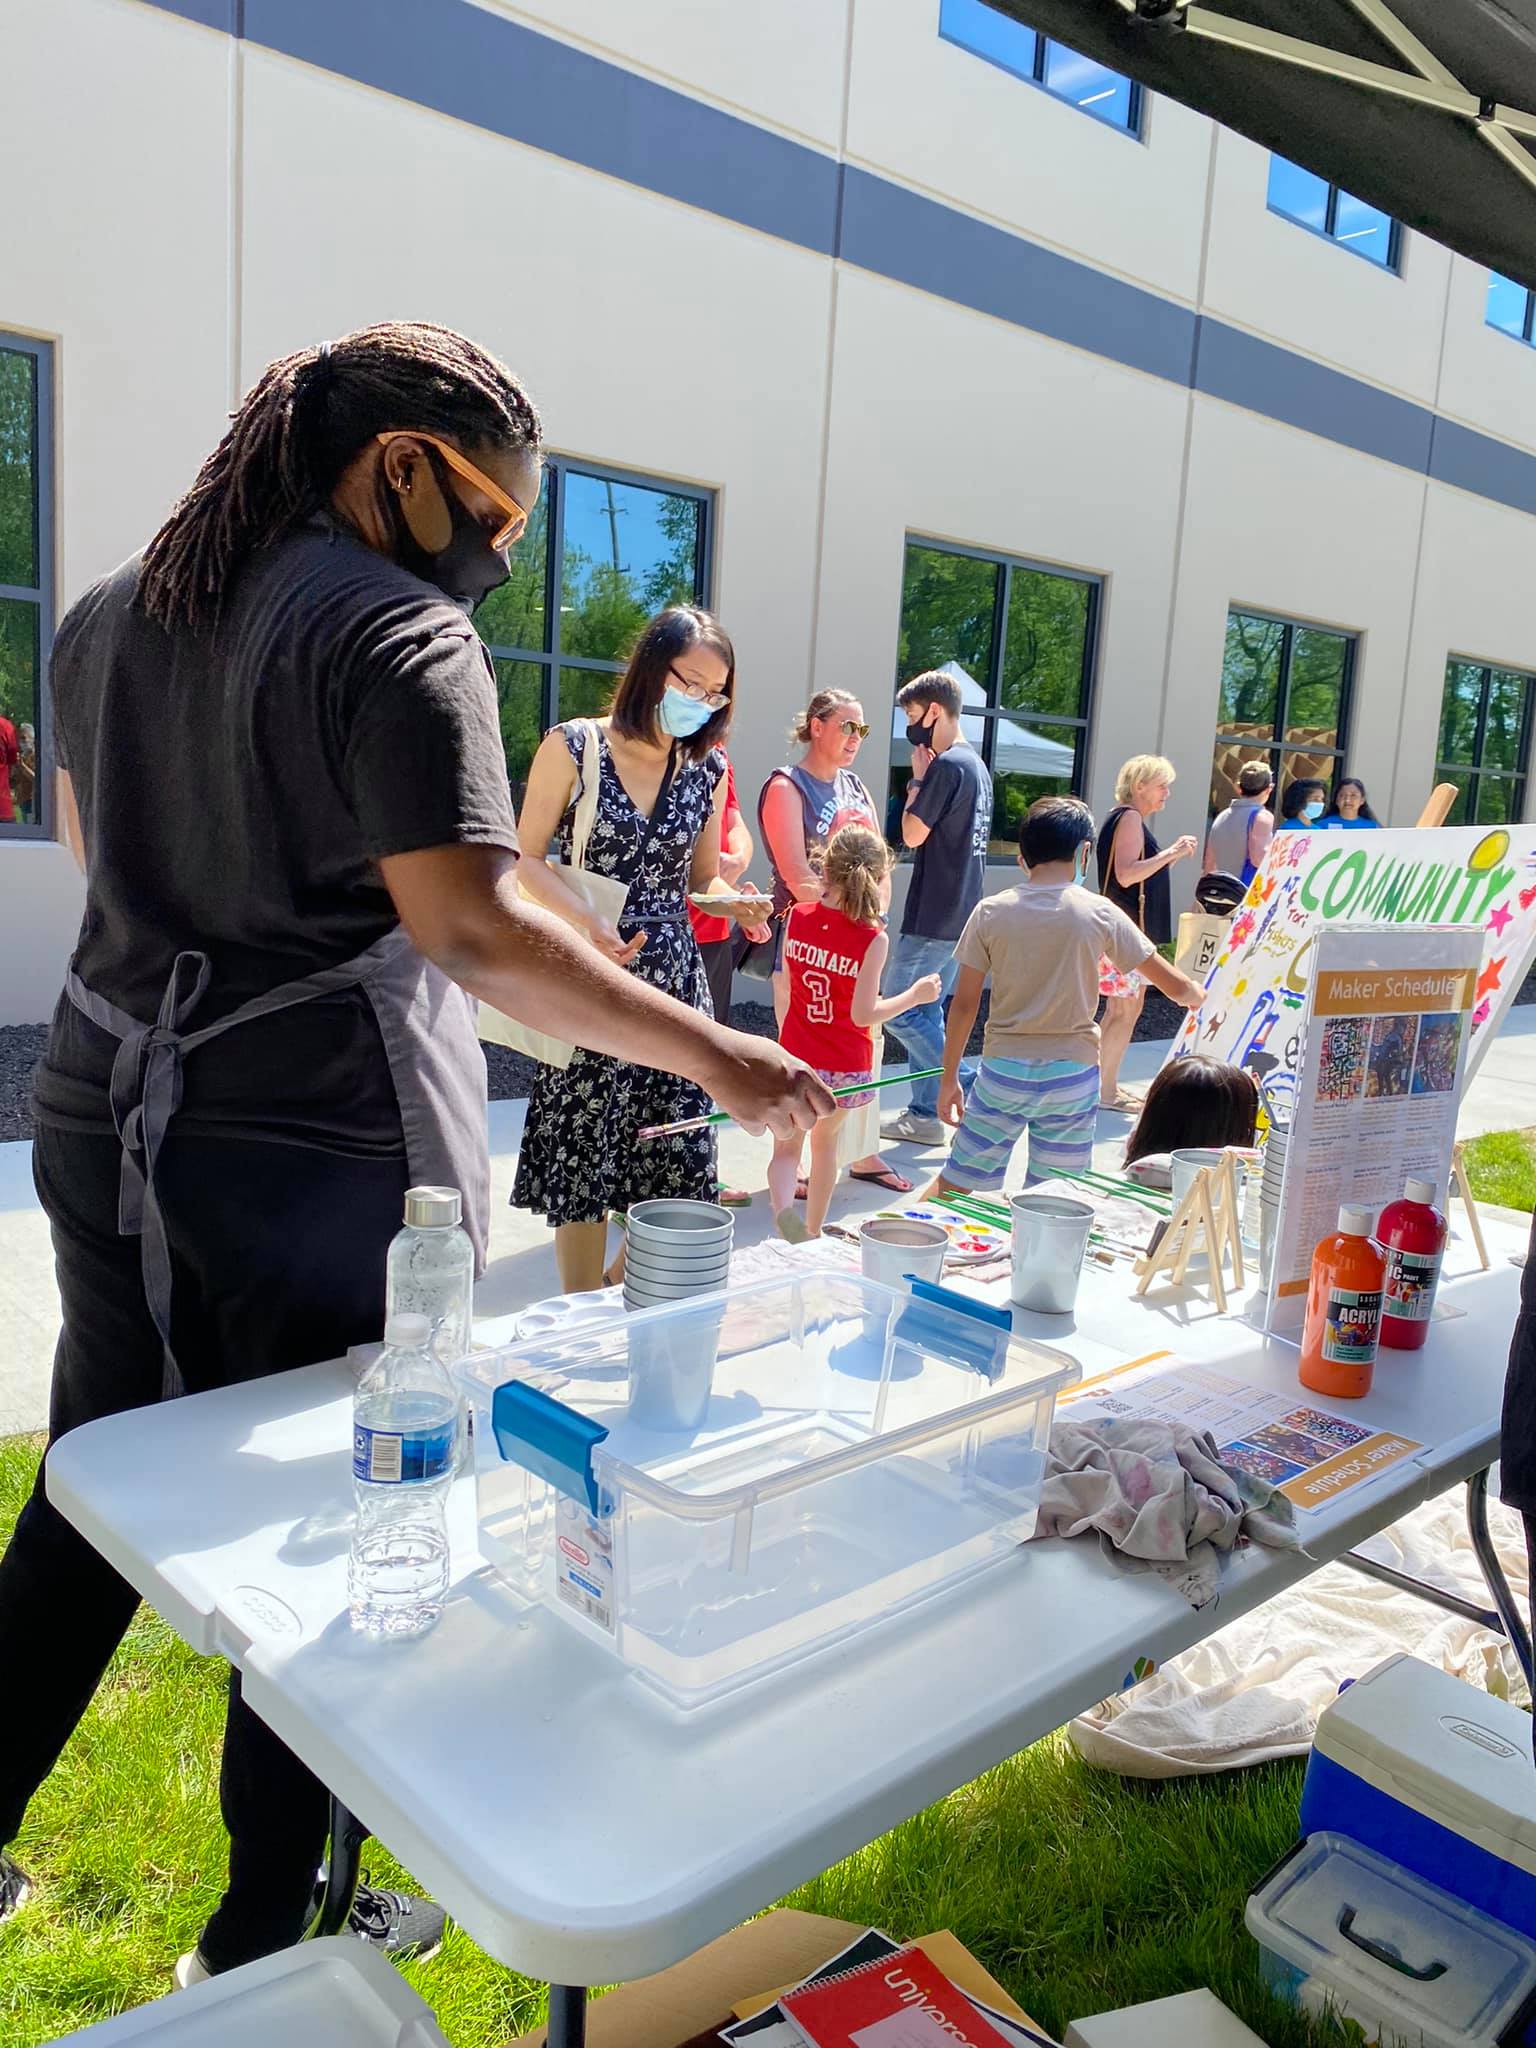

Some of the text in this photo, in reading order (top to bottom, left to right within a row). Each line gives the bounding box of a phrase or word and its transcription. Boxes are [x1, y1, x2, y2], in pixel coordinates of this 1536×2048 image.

[1300, 848, 1516, 924] COMMUNITY
[801, 969, 834, 1024] 3
[1328, 975, 1457, 999] Maker Schedule
[1303, 1439, 1409, 1495] Maker Schedule
